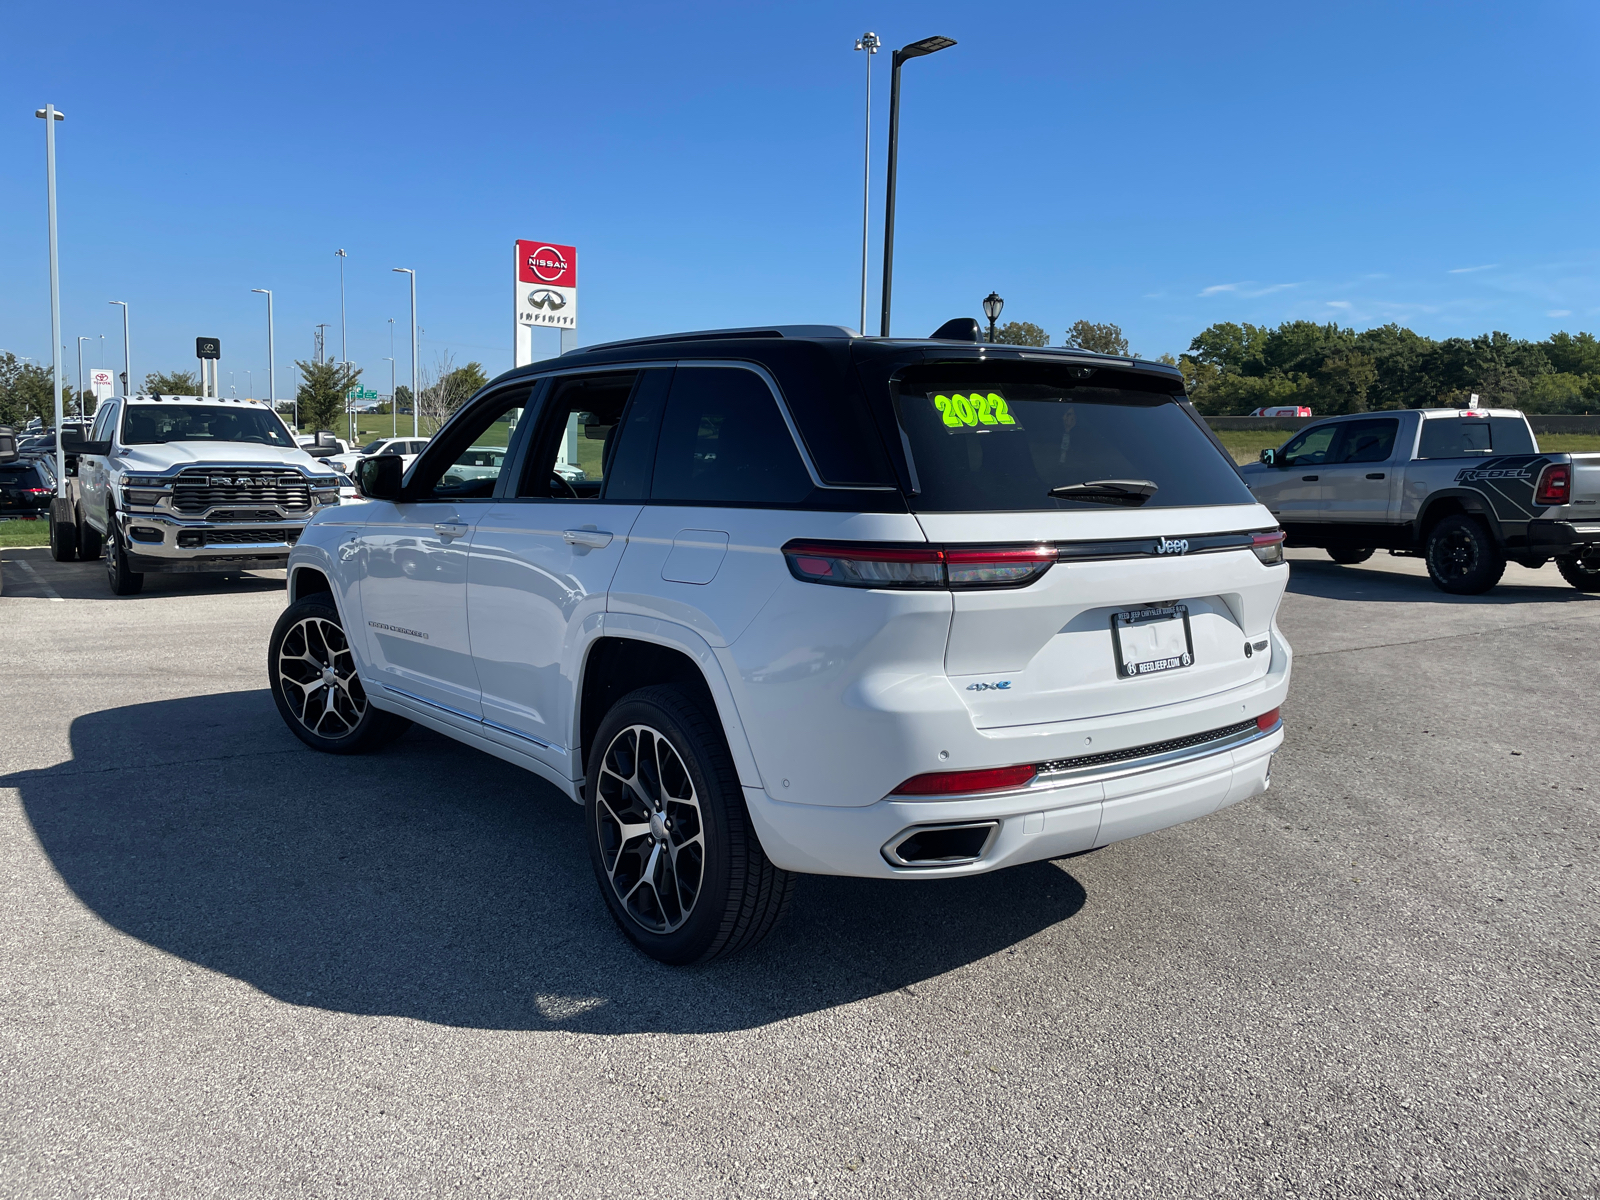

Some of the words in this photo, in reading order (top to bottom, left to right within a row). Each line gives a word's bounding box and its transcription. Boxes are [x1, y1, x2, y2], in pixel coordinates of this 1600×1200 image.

[528, 258, 567, 269] NISSAN
[520, 312, 574, 325] INFINITI
[934, 393, 1016, 428] 2022
[1454, 467, 1532, 481] REBEL
[210, 477, 277, 486] RAM
[1157, 536, 1189, 556] Jeep
[1118, 612, 1130, 620] REED
[1130, 610, 1140, 618] JEEP
[1140, 607, 1162, 617] CHRYSLER
[1139, 657, 1180, 673] REEDJEEP.COM
